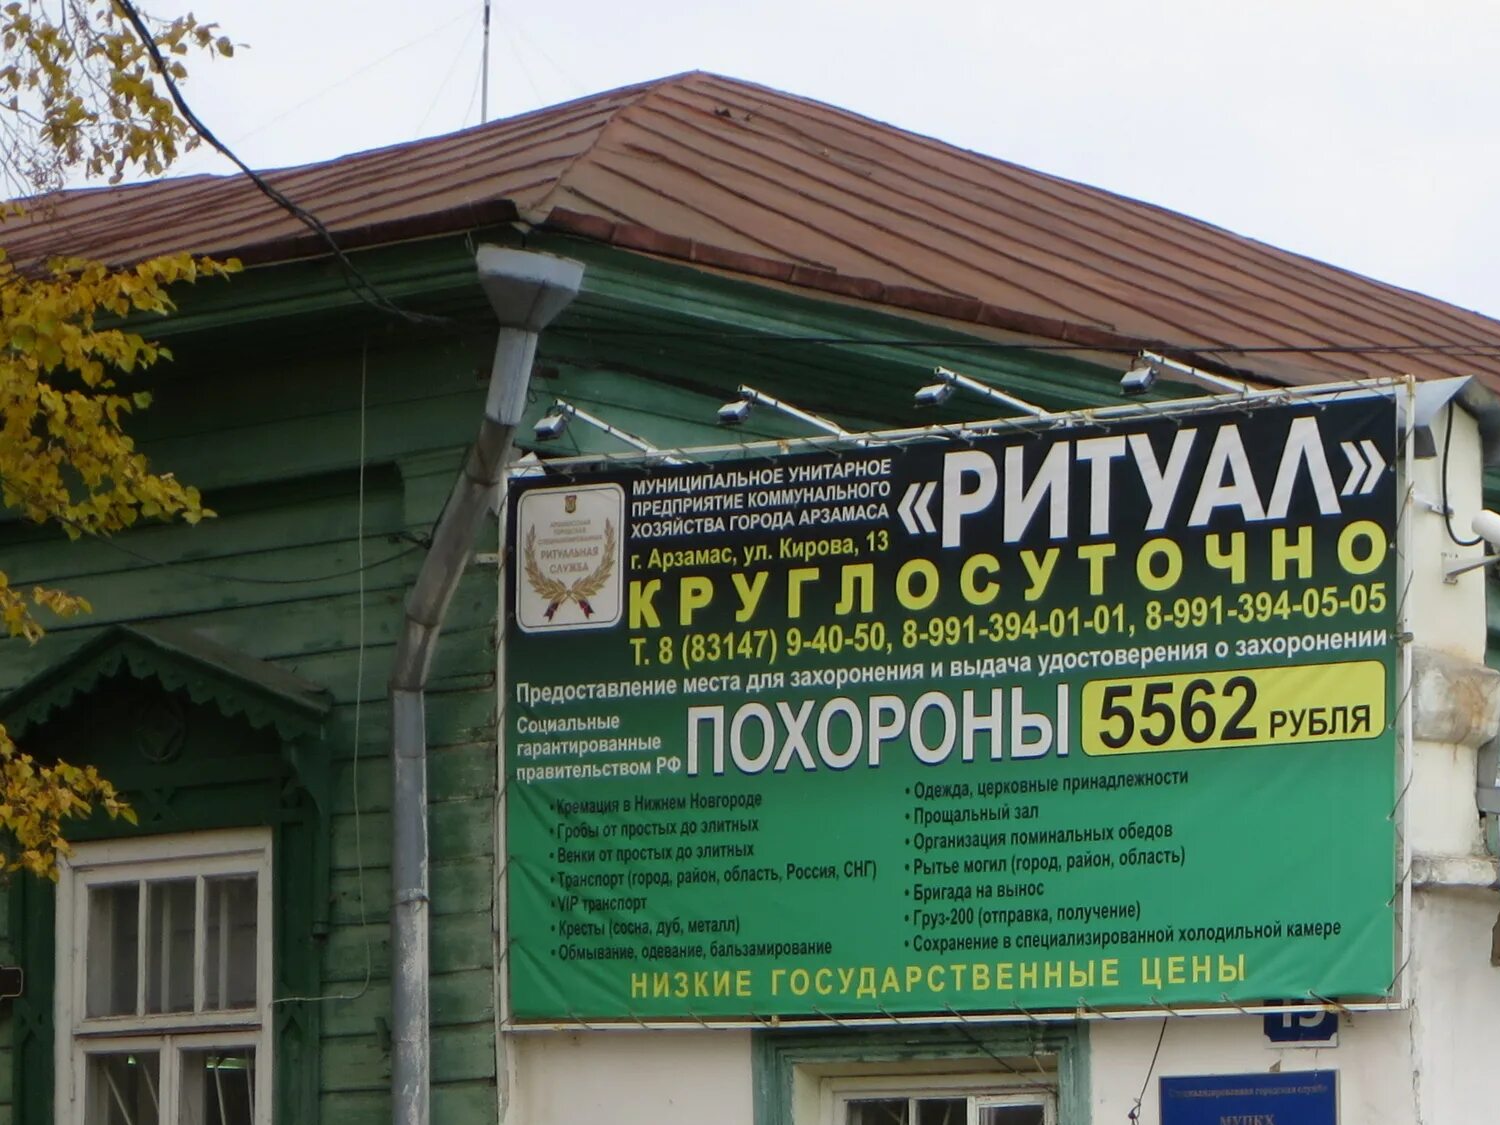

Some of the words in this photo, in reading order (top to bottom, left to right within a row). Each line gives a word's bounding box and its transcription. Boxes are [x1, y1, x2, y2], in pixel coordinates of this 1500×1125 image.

[633, 468, 783, 495] МУНИЦИПАЛЬНОЕ
[788, 458, 891, 484] УНИТАРНОЕ
[898, 416, 1387, 548] «РИТУАЛ»
[632, 492, 743, 518] ПРЕДПРИЯТИЕ
[748, 480, 890, 508] КОММУНАЛЬНОГО
[631, 514, 725, 539] ХОЗЯЙСТВА
[729, 509, 795, 533] ГОРОДА
[799, 503, 889, 528] АРЗАМАСА
[630, 552, 643, 571] г.
[648, 542, 739, 573] Арзамас,
[743, 544, 773, 569] ул.
[780, 533, 859, 563] Кирова,
[867, 529, 889, 552] 13
[629, 520, 1387, 630] КРУГЛОСУТОЧНО
[630, 637, 650, 667] Т.
[659, 635, 673, 664] 8
[681, 628, 778, 670] (83147)
[786, 621, 893, 658] 9-40-50,
[902, 602, 1136, 646] 8-991-394-01-01,
[1145, 583, 1386, 632] 8-991-394-05-05
[516, 672, 677, 706] Предоставление
[683, 674, 741, 696] места
[746, 669, 785, 692] для
[790, 662, 925, 692] захоронения
[931, 664, 945, 681] и
[950, 656, 1032, 679] выдача
[1037, 640, 1208, 677] удостоверения
[1215, 642, 1229, 658] о
[1235, 628, 1387, 658] захоронении
[517, 713, 620, 736] Социальные
[687, 682, 1070, 775] ПОХОРОНЫ
[1098, 675, 1258, 750] 5562
[1269, 703, 1372, 739] РУБЛЯ
[517, 735, 661, 758] гарантированные
[517, 760, 652, 784] правительством
[656, 757, 682, 778] РФ
[913, 781, 974, 802] Одежда,
[977, 775, 1058, 797] церковные
[1062, 768, 1190, 794] принадлежности
[557, 798, 620, 817] Кремация
[623, 800, 631, 811] в
[634, 794, 686, 812] Нижнем
[690, 790, 762, 812] Новгороде
[913, 803, 1013, 826] Прощальный
[1015, 803, 1040, 820] зал
[557, 821, 599, 841] Гробы
[603, 824, 618, 837] от
[620, 821, 677, 841] простых
[680, 820, 697, 837] до
[701, 817, 760, 835] элитных
[913, 829, 1007, 852] Организация
[1010, 823, 1114, 848] поминальных
[1118, 820, 1174, 841] обедов
[557, 845, 596, 863] Венки
[599, 848, 613, 862] от
[616, 844, 673, 864] простых
[676, 844, 693, 860] до
[697, 841, 754, 860] элитных
[913, 858, 960, 877] Рытье
[963, 854, 1007, 874] могил
[1011, 851, 1063, 875] (город,
[1066, 848, 1114, 871] район,
[1118, 845, 1187, 868] область)
[557, 868, 625, 890] Транспорт
[628, 868, 674, 890] (город,
[677, 866, 719, 887] район,
[723, 864, 783, 885] область,
[786, 861, 840, 882] Россия,
[844, 858, 878, 880] СНГ)
[557, 894, 579, 912] VIP
[583, 895, 648, 915] транспорт
[913, 882, 973, 903] Бригада
[976, 884, 994, 899] на
[997, 881, 1045, 898] вынос
[558, 919, 605, 937] Кресты
[608, 916, 654, 938] (сосна,
[656, 917, 686, 936] дуб,
[688, 913, 740, 936] металл)
[913, 907, 975, 930] Груз-200
[978, 903, 1052, 927] (отправка,
[1056, 900, 1141, 924] получение)
[558, 941, 639, 962] Обмывание,
[641, 940, 707, 961] одевание,
[710, 939, 833, 961] бальзамирование
[912, 932, 1000, 956] Сохранение
[1003, 936, 1012, 949] в
[1015, 924, 1174, 951] специализированной
[1178, 920, 1283, 943] холодильной
[1286, 919, 1342, 943] камере
[630, 970, 753, 999] НИЗКИЕ
[770, 958, 1120, 1000] ГОСУДАРСТВЕННЫЕ
[1140, 953, 1247, 990] ЦЕНЫ
